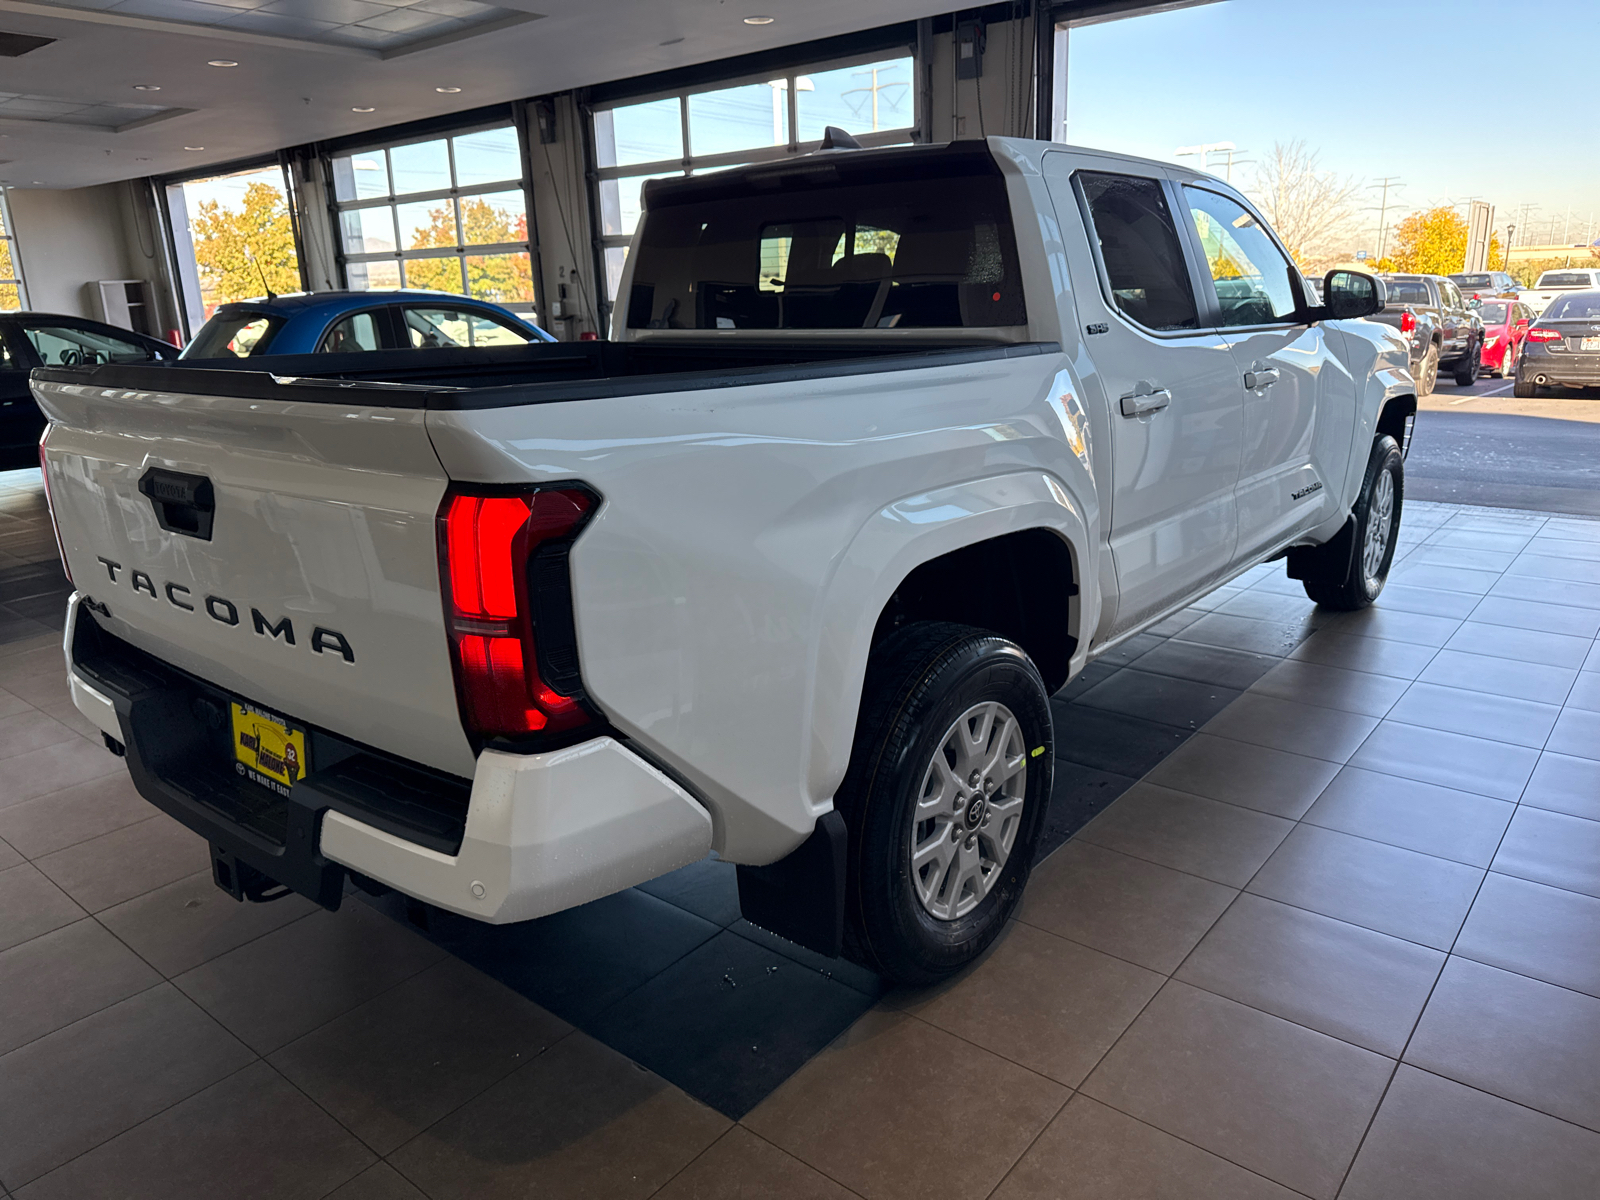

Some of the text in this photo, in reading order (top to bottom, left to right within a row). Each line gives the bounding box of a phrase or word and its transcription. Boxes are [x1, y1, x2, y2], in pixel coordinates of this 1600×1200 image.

[559, 266, 565, 278] 2
[154, 481, 187, 499] TOYOTA
[1291, 481, 1322, 501] TACOMA
[97, 556, 355, 664] TACOMA
[240, 731, 256, 753] KARL
[259, 750, 285, 777] MALONE
[286, 748, 296, 762] 32
[247, 770, 290, 798] WE MAKE IT EASY
